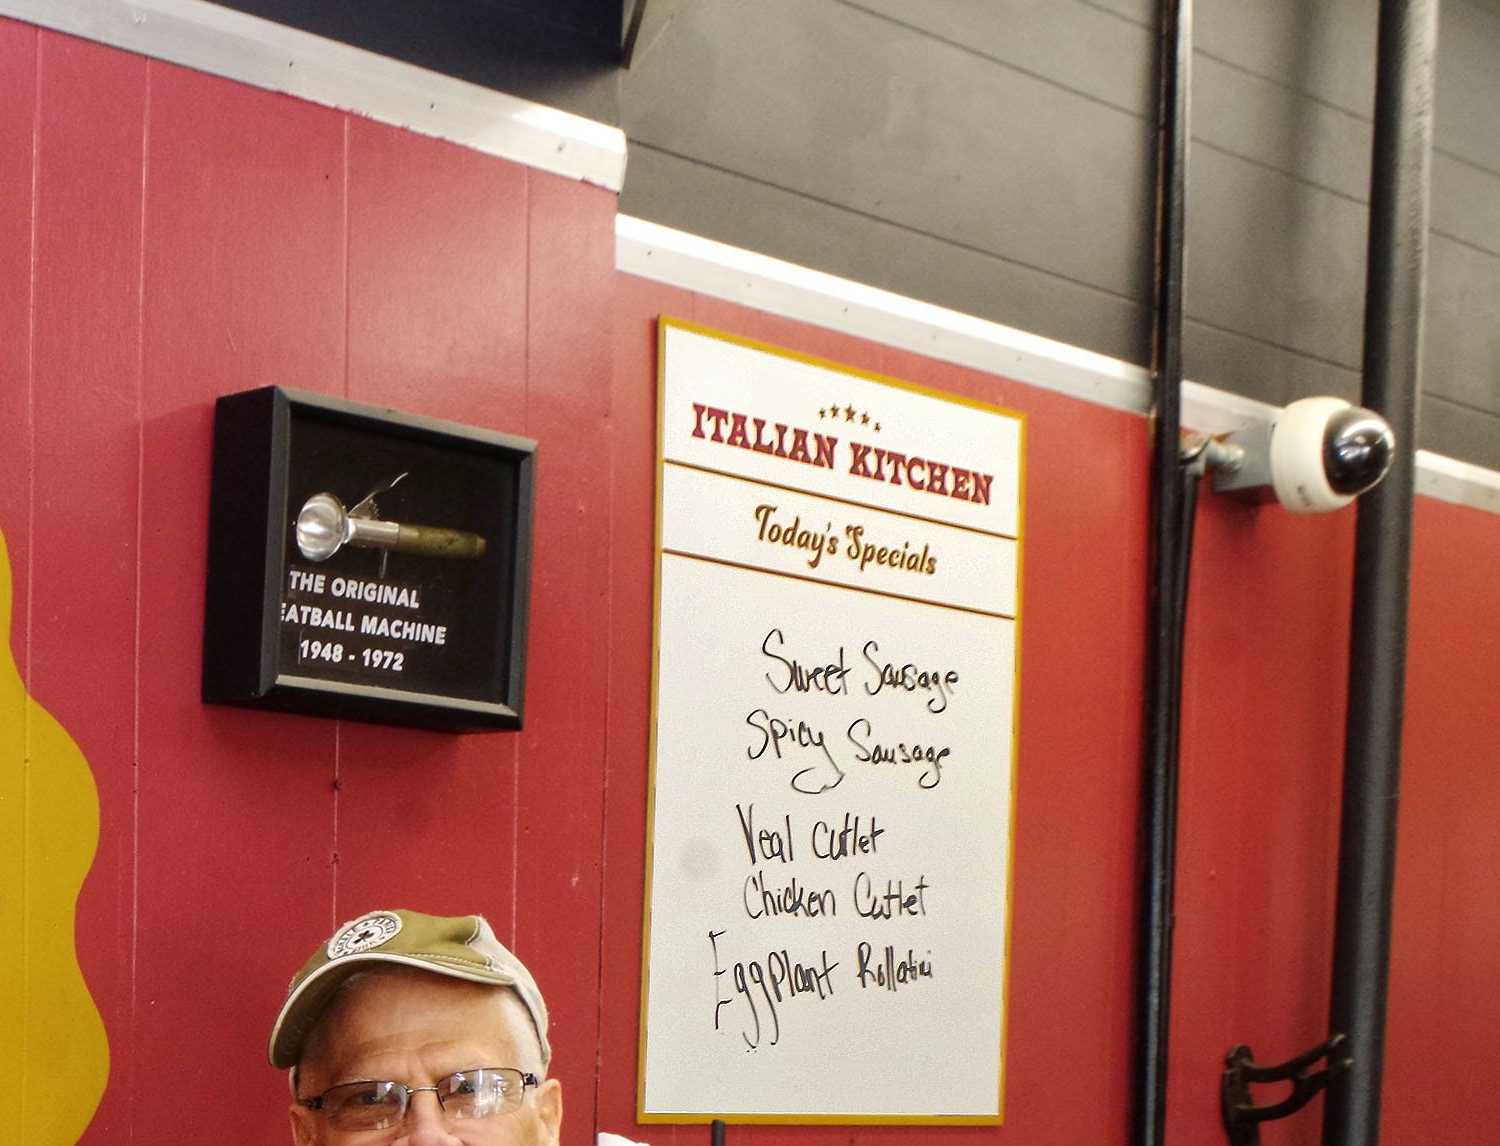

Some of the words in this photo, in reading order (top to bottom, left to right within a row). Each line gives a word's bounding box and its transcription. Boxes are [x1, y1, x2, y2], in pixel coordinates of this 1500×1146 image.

[691, 402, 838, 470] ITALIAN
[849, 442, 994, 506] KITCHEN
[754, 504, 839, 569] Today's
[845, 524, 937, 575] Specials
[289, 570, 326, 594] THE
[331, 577, 420, 609] ORIGINAL
[280, 602, 355, 632] EATBALL
[360, 614, 447, 645] MACHINE
[300, 639, 344, 663] 1948
[362, 648, 405, 672] 1972
[761, 628, 852, 695] Sweet
[862, 640, 960, 714] Sausage
[746, 708, 846, 795] Spicy
[847, 718, 952, 790] Sausage
[735, 803, 795, 866] Veal
[812, 812, 886, 862] Cutlet
[743, 870, 838, 921] Chicken
[853, 871, 931, 921] Cutlet
